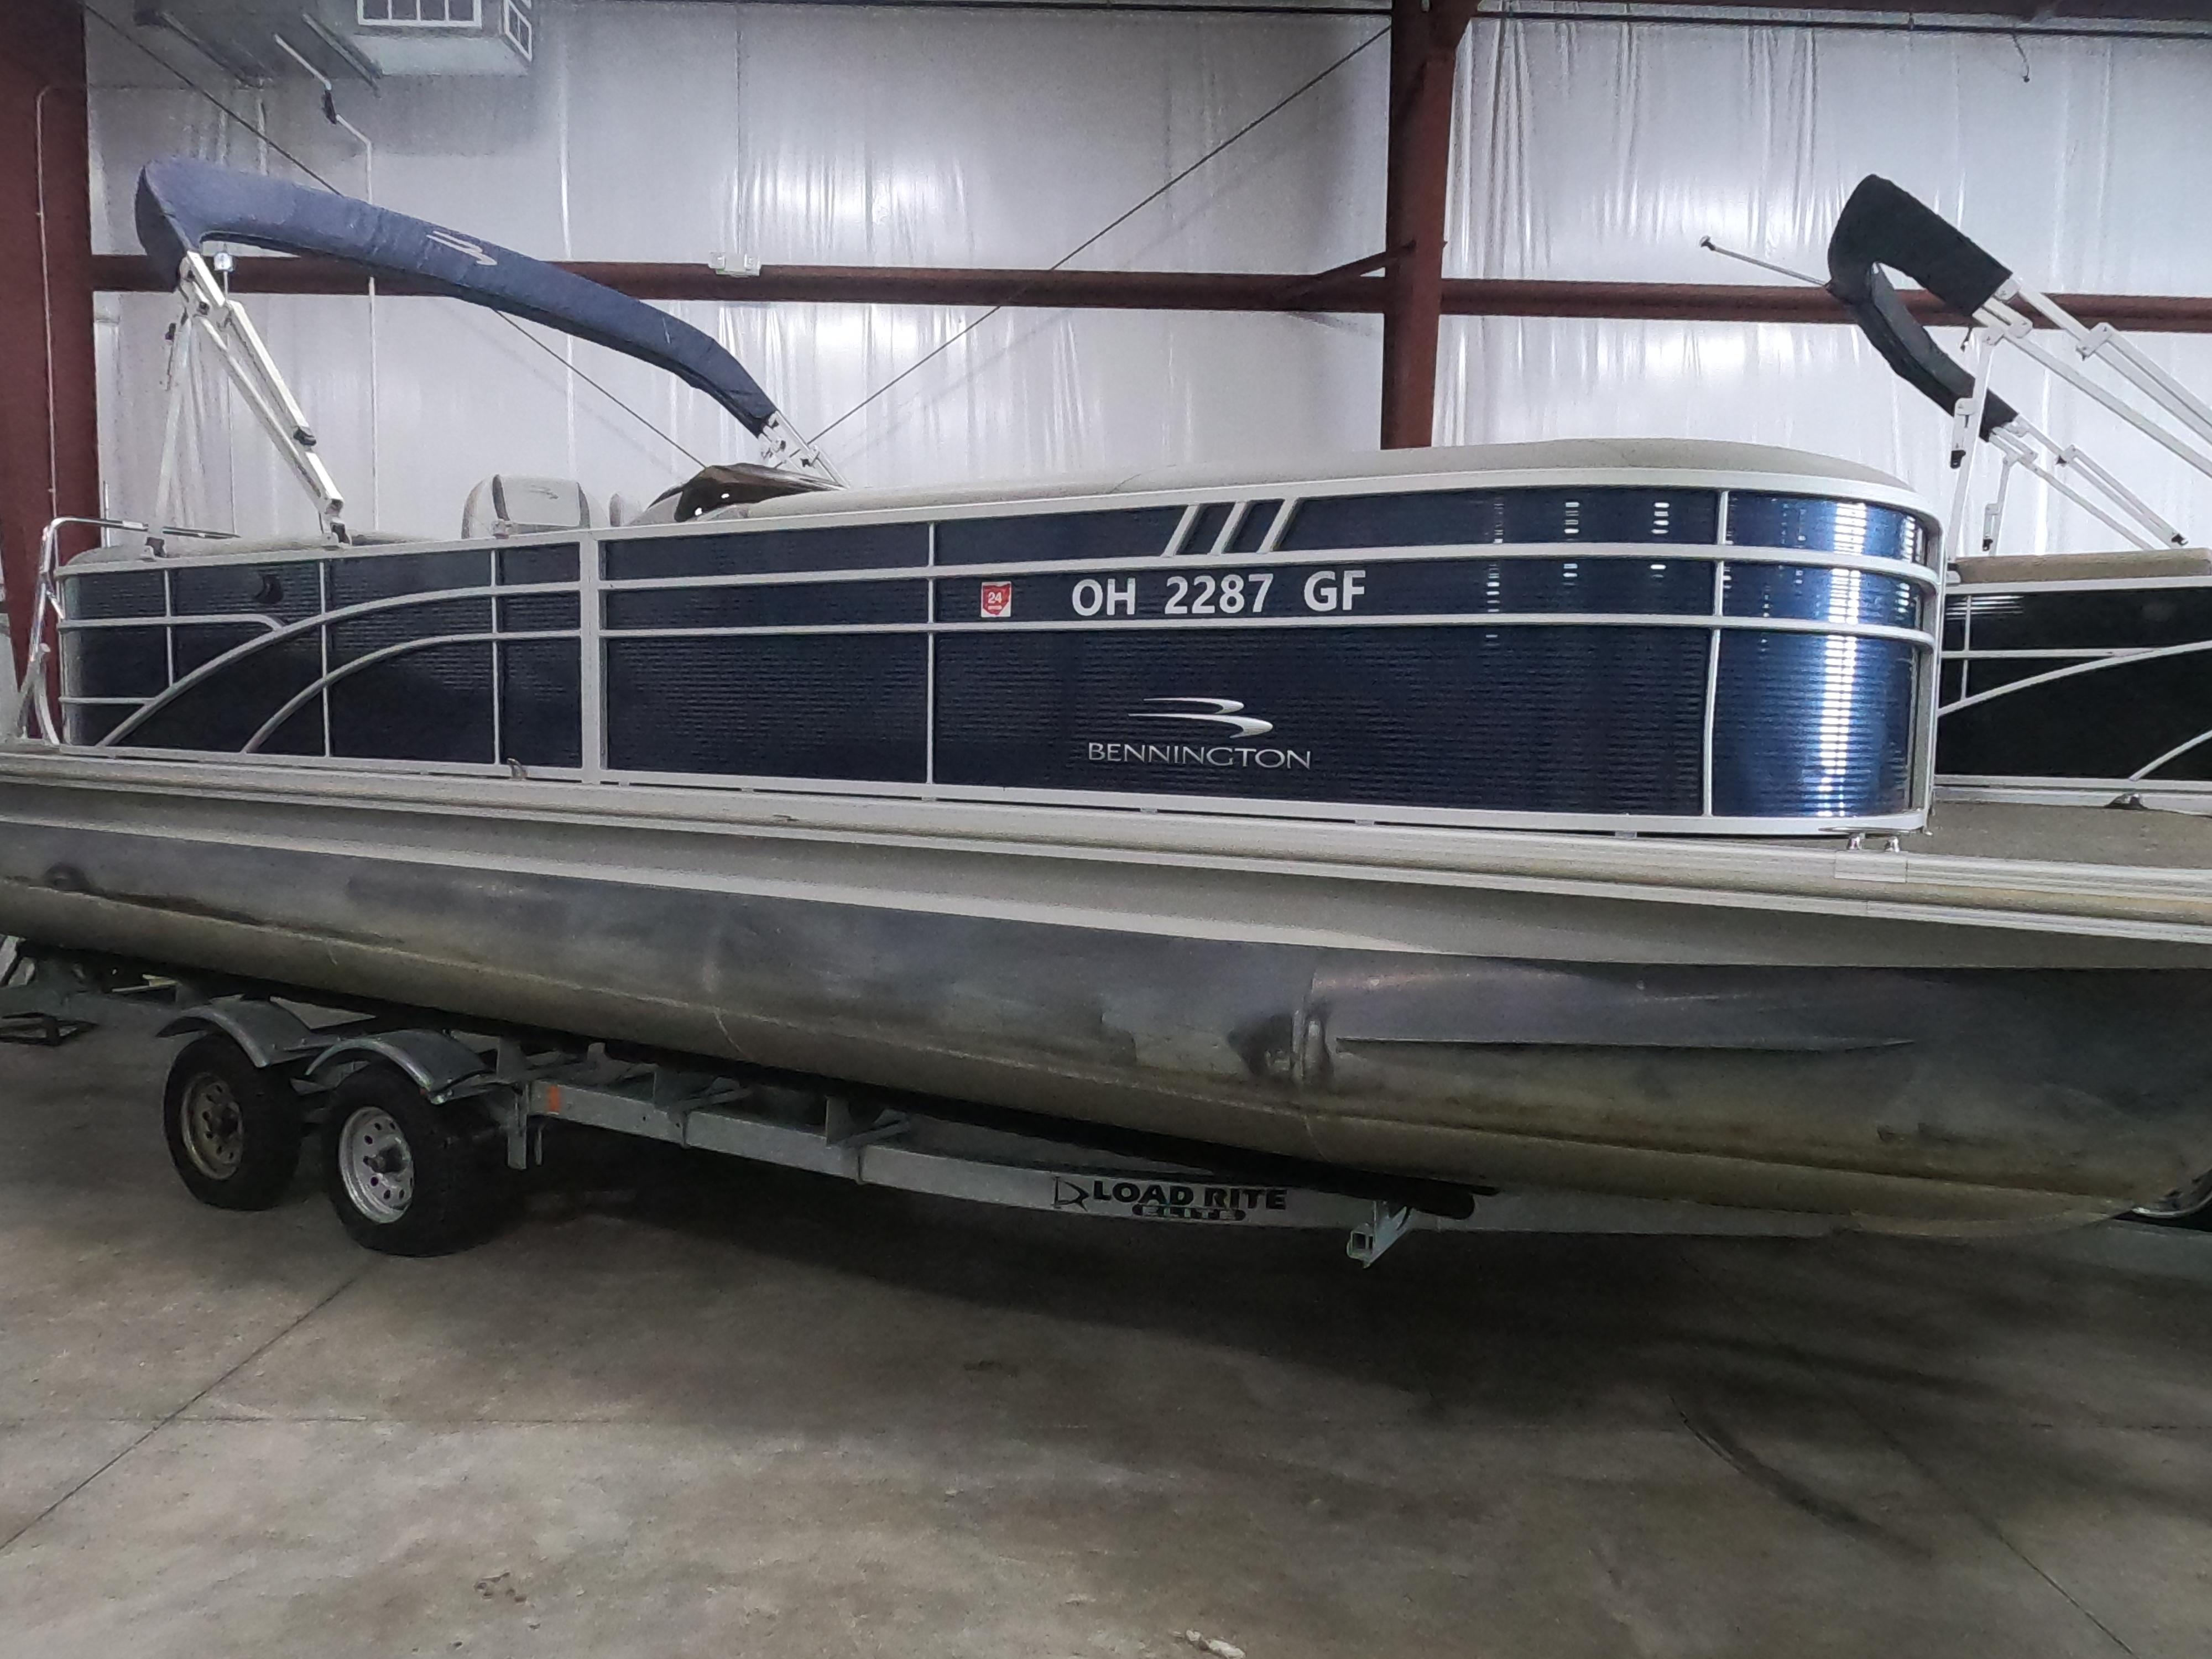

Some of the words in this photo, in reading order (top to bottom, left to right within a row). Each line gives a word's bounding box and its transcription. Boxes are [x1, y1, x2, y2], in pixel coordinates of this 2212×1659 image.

[988, 591, 1002, 603] 24
[1072, 578, 1136, 616] OH
[1165, 573, 1274, 614] 2287
[1304, 570, 1366, 612] GF
[1088, 742, 1311, 769] BENNINGTON
[1094, 1180, 1194, 1206] LOAD
[1204, 1187, 1288, 1210] RITE
